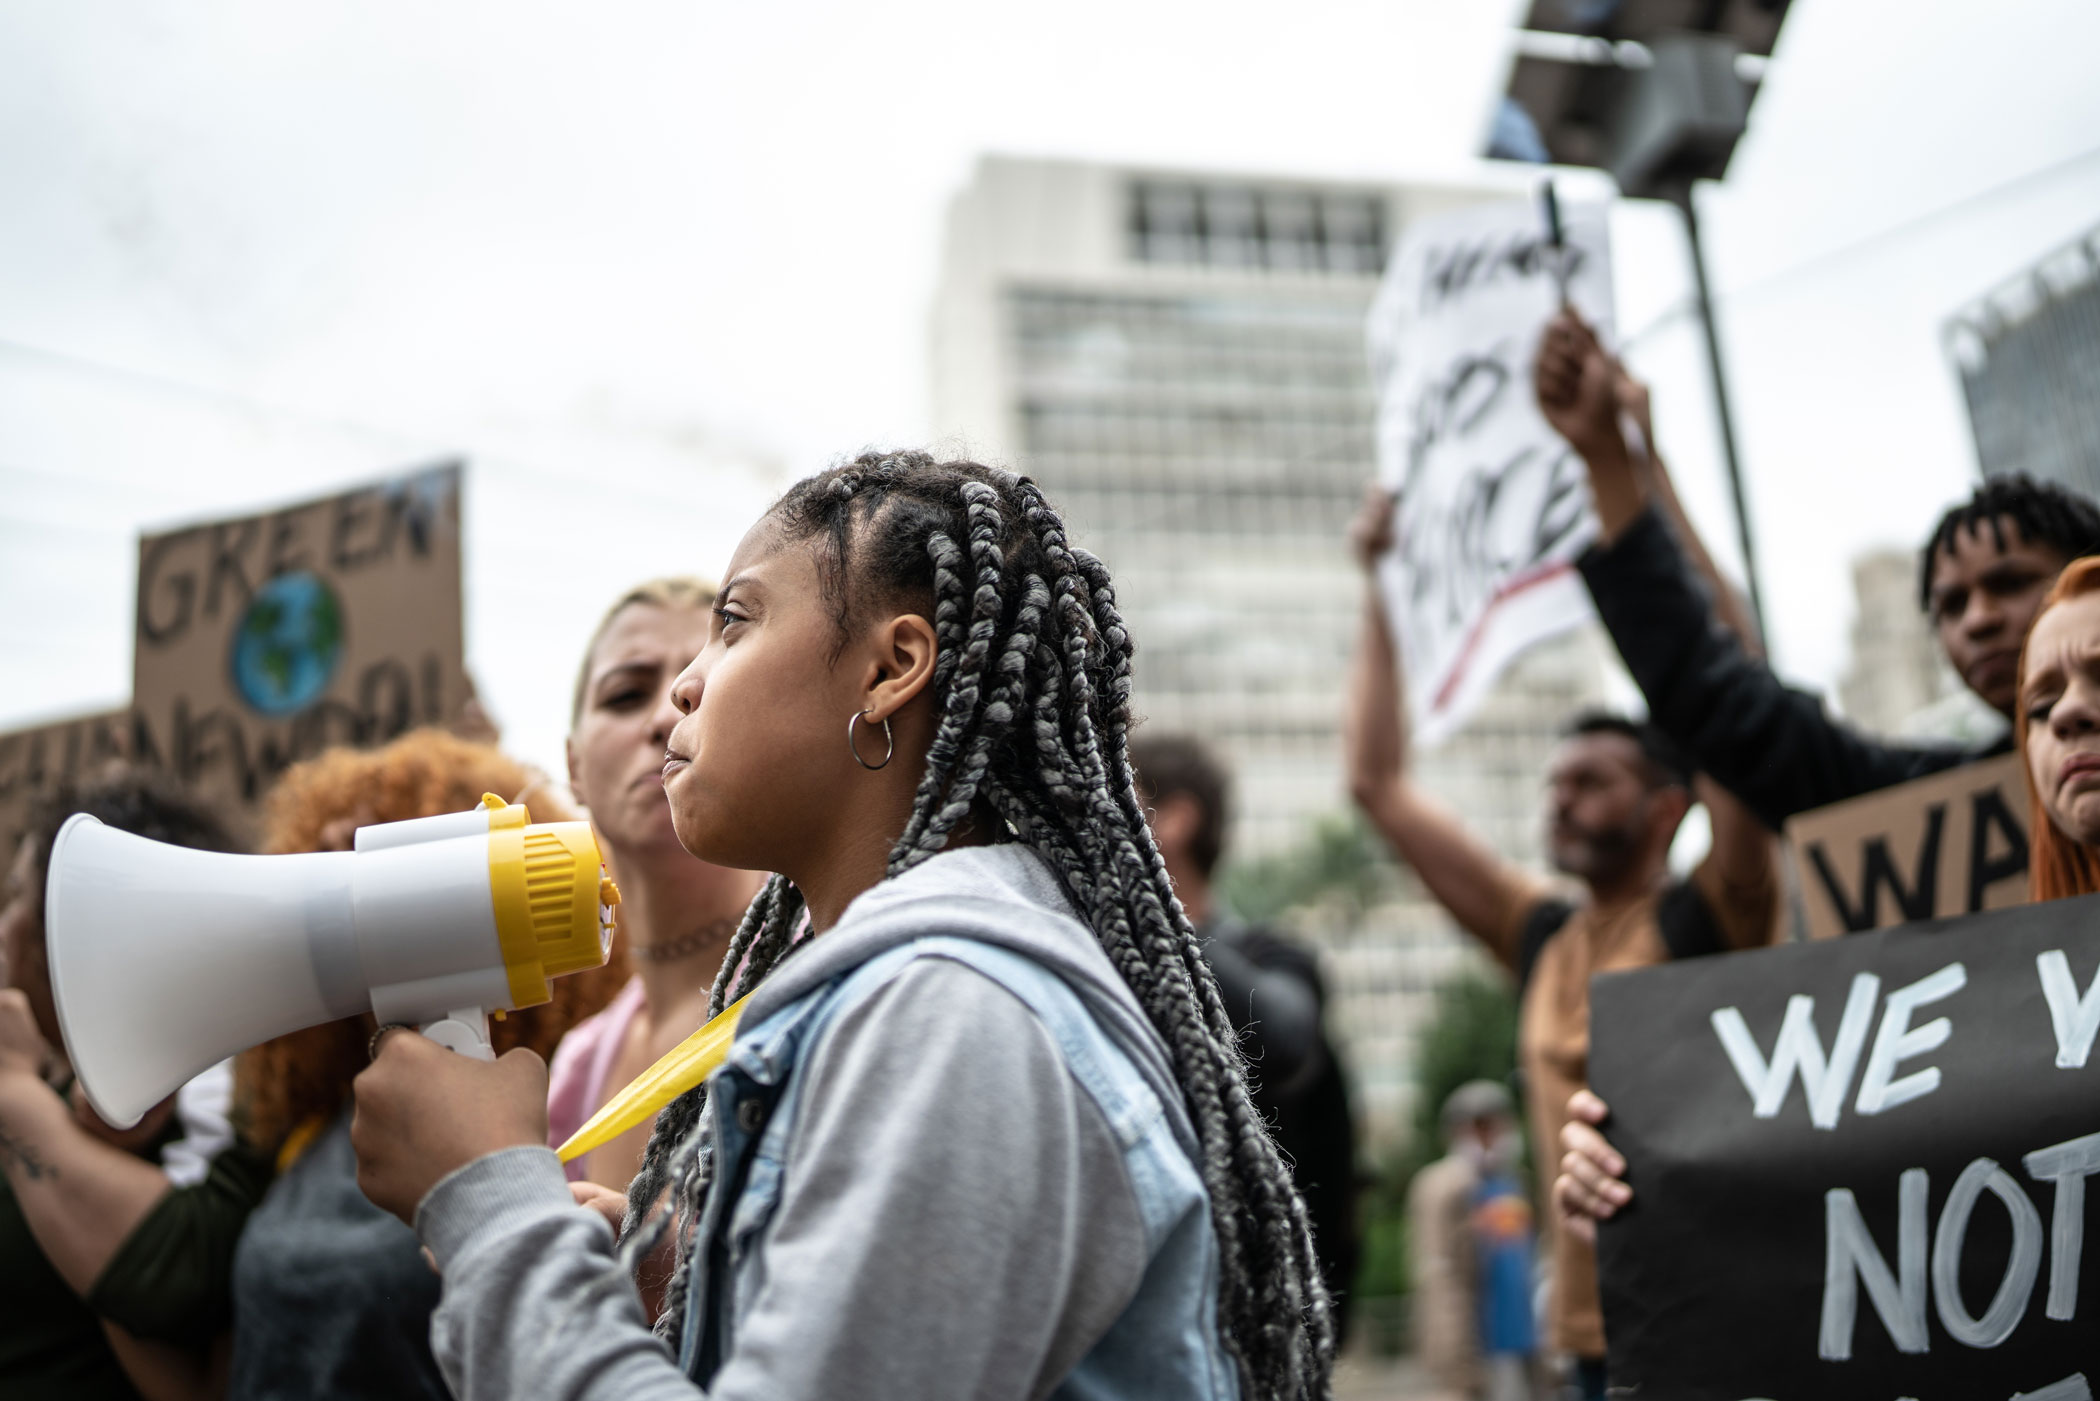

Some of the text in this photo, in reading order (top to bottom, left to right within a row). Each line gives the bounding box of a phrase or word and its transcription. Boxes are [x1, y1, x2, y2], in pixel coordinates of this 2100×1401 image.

[138, 482, 440, 647] GREEN
[1710, 962, 1967, 1130] WE
[1818, 1131, 2100, 1360] NOT
